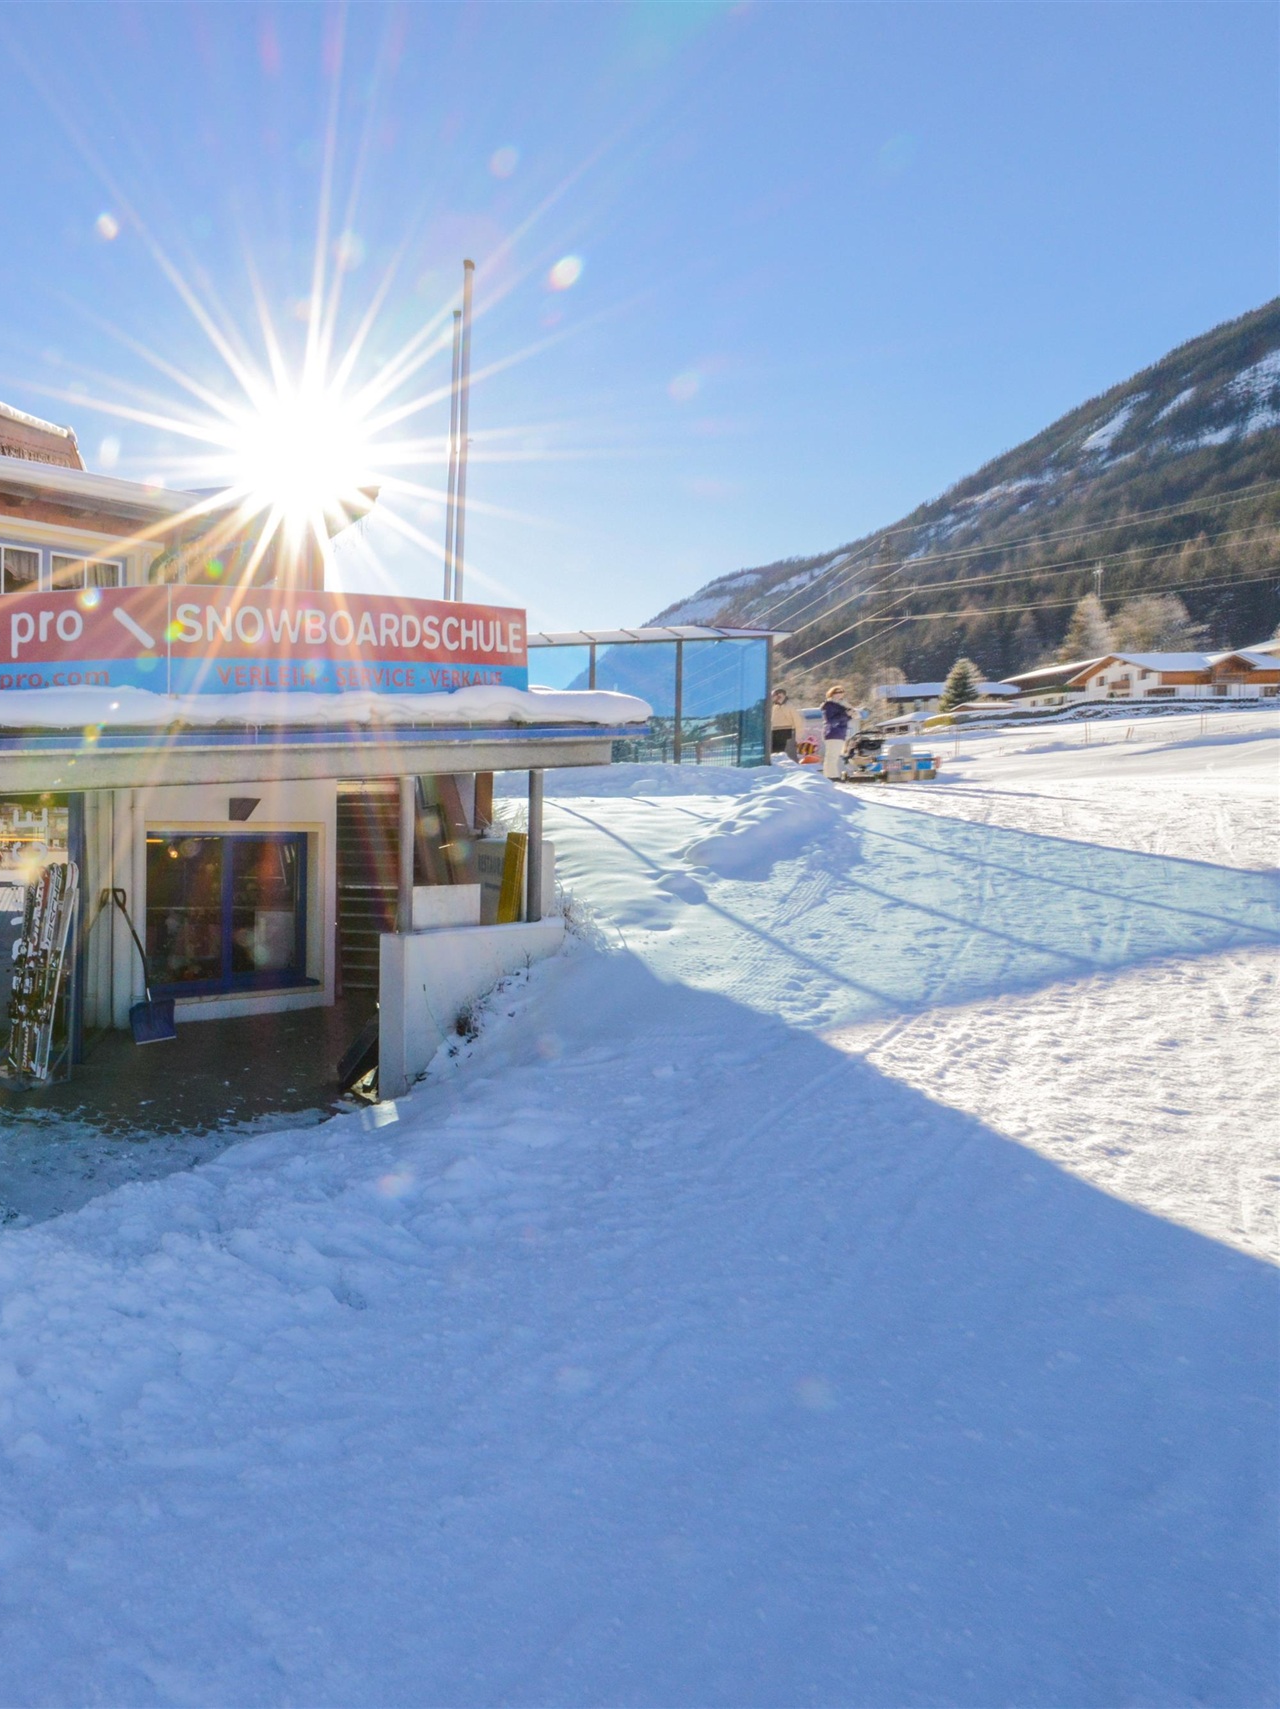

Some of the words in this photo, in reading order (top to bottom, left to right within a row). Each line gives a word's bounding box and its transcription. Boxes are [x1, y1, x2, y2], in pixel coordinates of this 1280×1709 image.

[10, 609, 84, 659] pro
[175, 602, 523, 655] SNOWBOARDSCHULE
[216, 665, 317, 687] VERLEIH
[335, 667, 416, 688] SERVICE
[429, 668, 504, 688] VERKAUF
